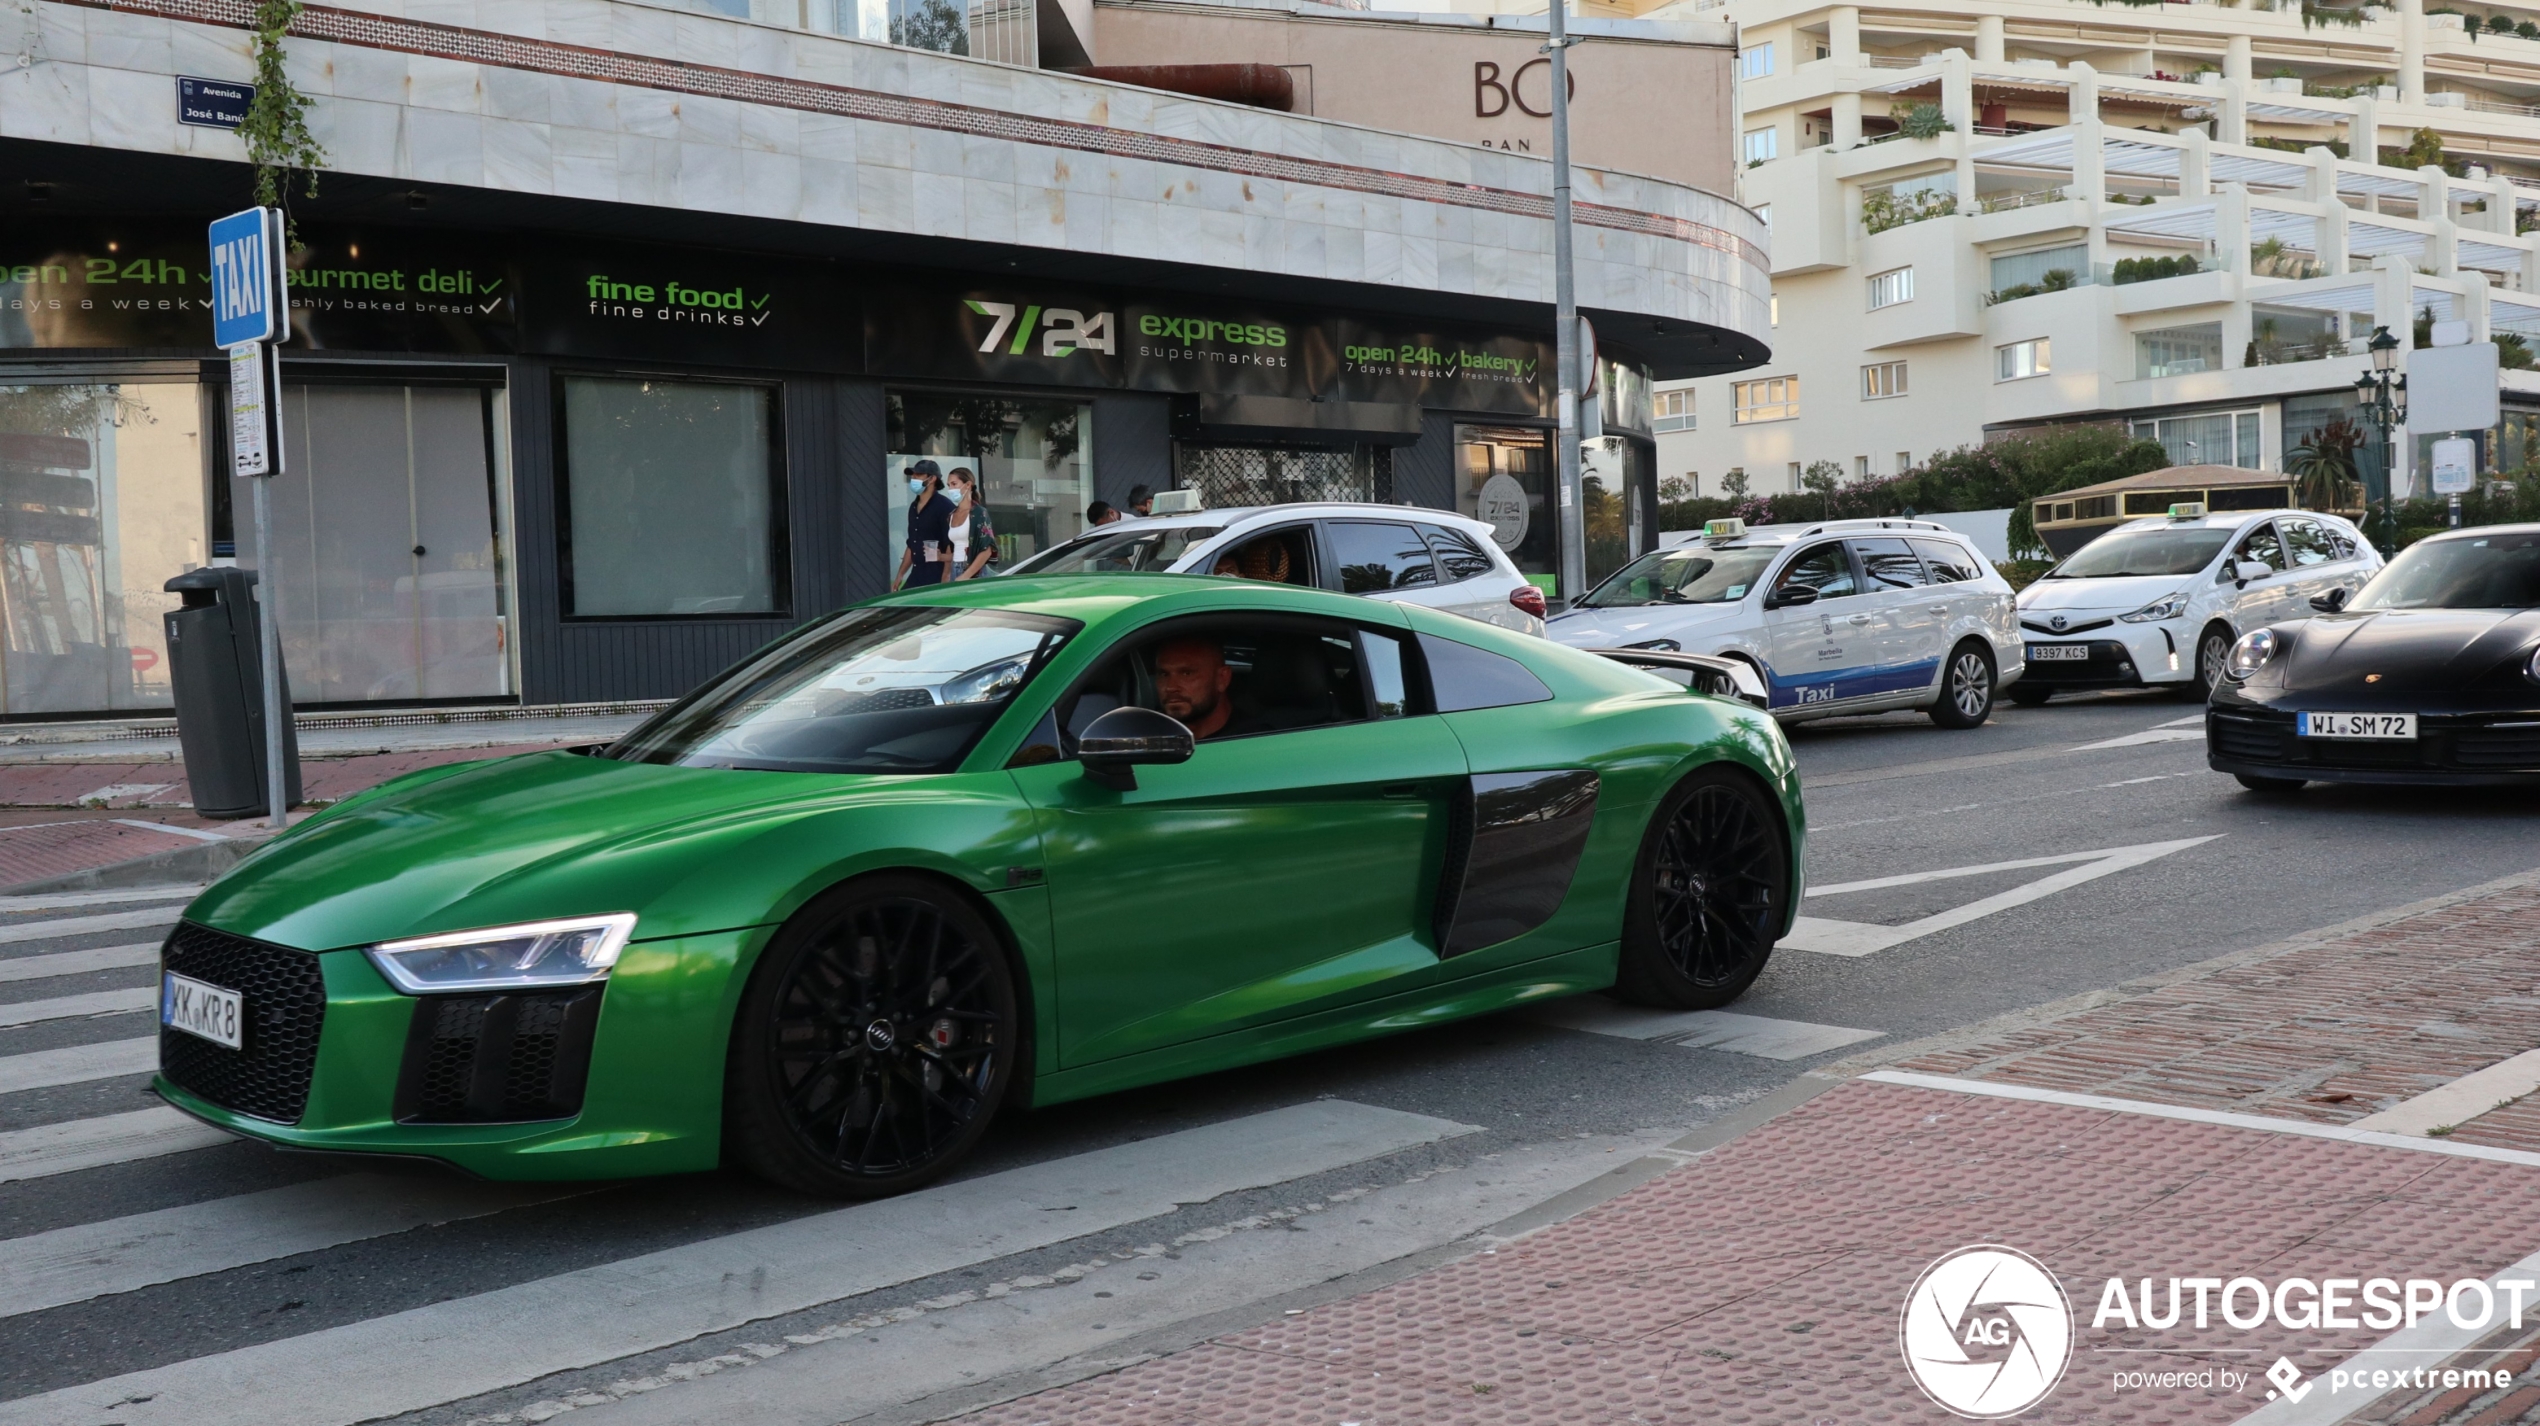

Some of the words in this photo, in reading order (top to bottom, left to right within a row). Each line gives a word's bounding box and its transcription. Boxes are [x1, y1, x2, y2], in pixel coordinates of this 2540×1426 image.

[203, 87, 242, 99] Avenida
[186, 107, 213, 119] José
[217, 111, 245, 123] Banú
[85, 259, 186, 285] 24h
[214, 234, 262, 322] TAXI
[286, 268, 405, 291] ourmet
[418, 268, 473, 294] deli
[586, 275, 655, 302] fine
[665, 281, 743, 310] food
[81, 299, 93, 309] a
[112, 297, 190, 310] week
[291, 298, 334, 311] shly
[344, 299, 405, 311] baked
[416, 302, 473, 314] bread
[589, 301, 644, 318] fine
[657, 306, 744, 326] drinks
[962, 299, 1116, 358] 7/24
[1139, 314, 1287, 347] express
[1140, 345, 1288, 368] supermarket
[1344, 345, 1396, 364] open
[1401, 345, 1442, 366] 24h
[1460, 350, 1524, 376] bakery
[1346, 362, 1354, 372] 7
[1360, 363, 1392, 376] days
[1398, 367, 1405, 376] a
[1410, 368, 1442, 378] week
[1460, 371, 1489, 381] fresh
[1493, 373, 1523, 383] bread
[1487, 501, 1520, 514] 7/24
[1712, 523, 1728, 535] TAXI
[1818, 647, 1843, 656] Marbella
[2035, 647, 2062, 659] 9397
[2065, 647, 2086, 659] KCS
[1795, 683, 1835, 704] Taxi
[2313, 716, 2336, 734] WI
[2350, 716, 2376, 735] SM
[2381, 717, 2406, 735] 72
[201, 990, 222, 1037] KR
[225, 1000, 235, 1039] 8
